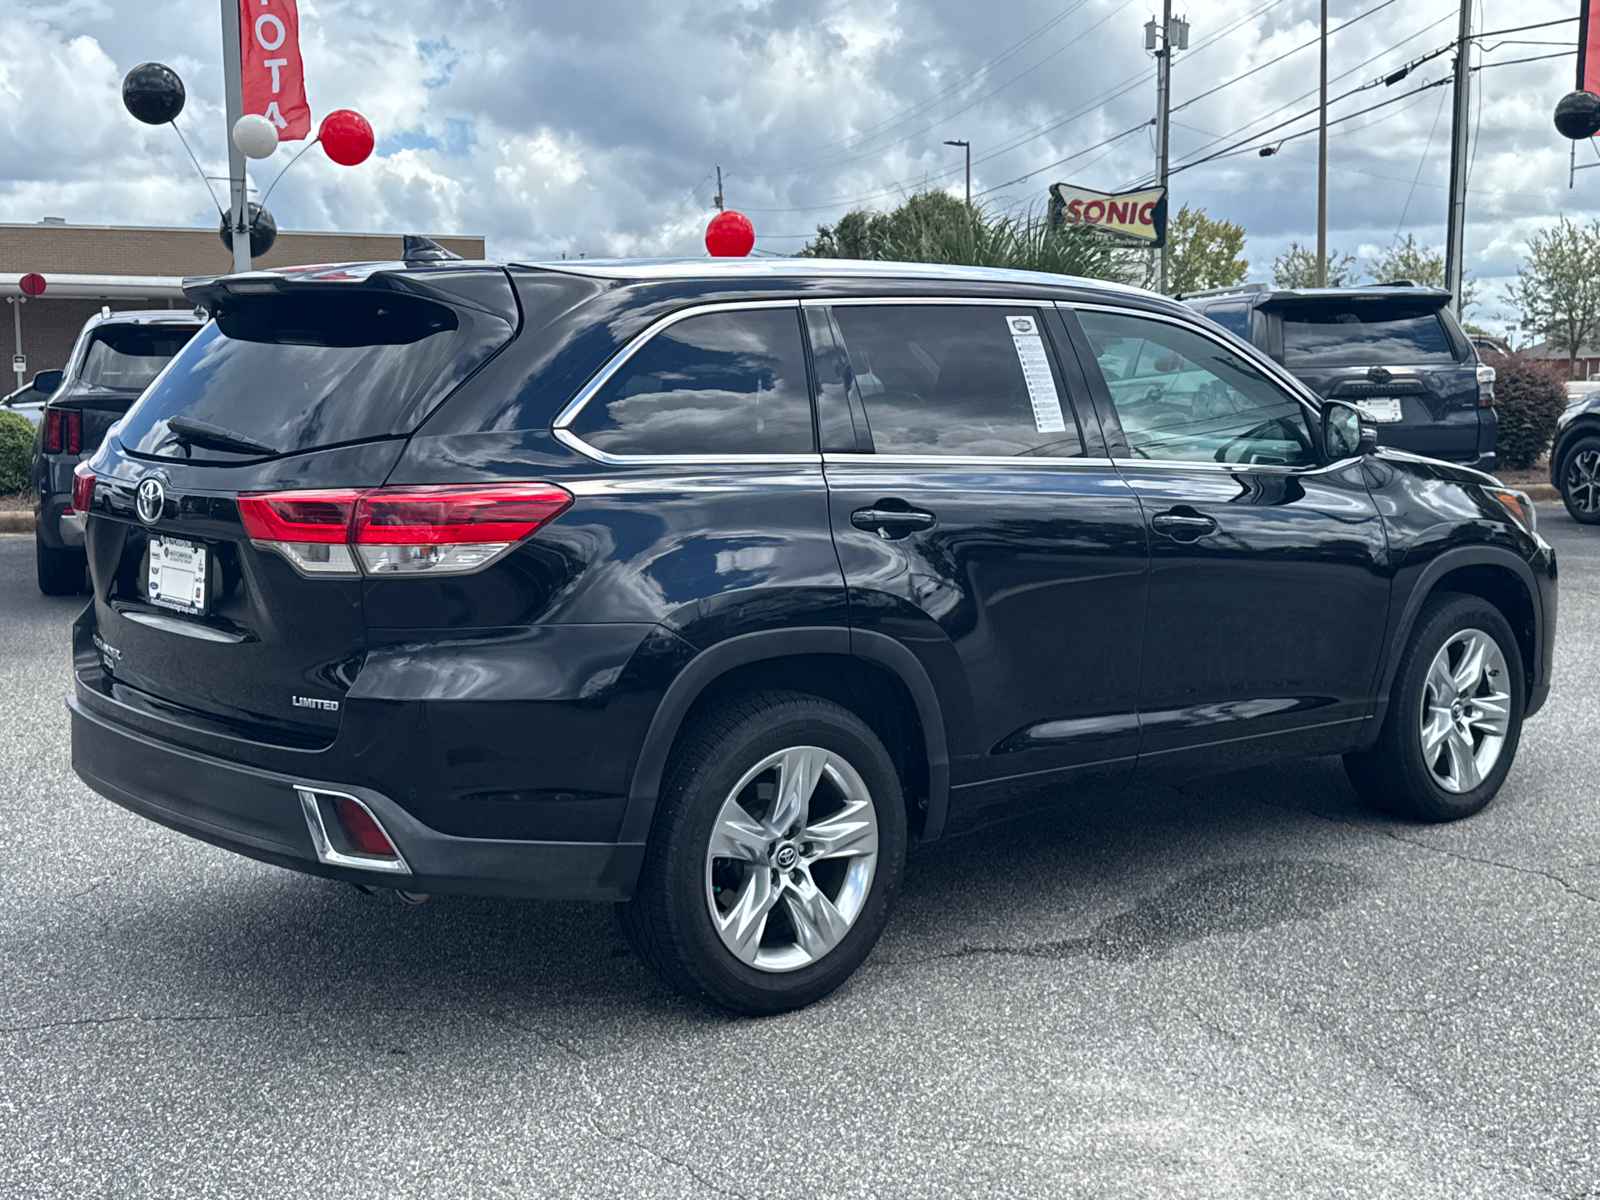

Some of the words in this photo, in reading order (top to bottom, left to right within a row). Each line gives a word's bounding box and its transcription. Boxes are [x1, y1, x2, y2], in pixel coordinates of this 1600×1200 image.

[255, 0, 288, 129] OTA
[1065, 198, 1157, 226] SONIC
[292, 695, 339, 711] LIMITED
